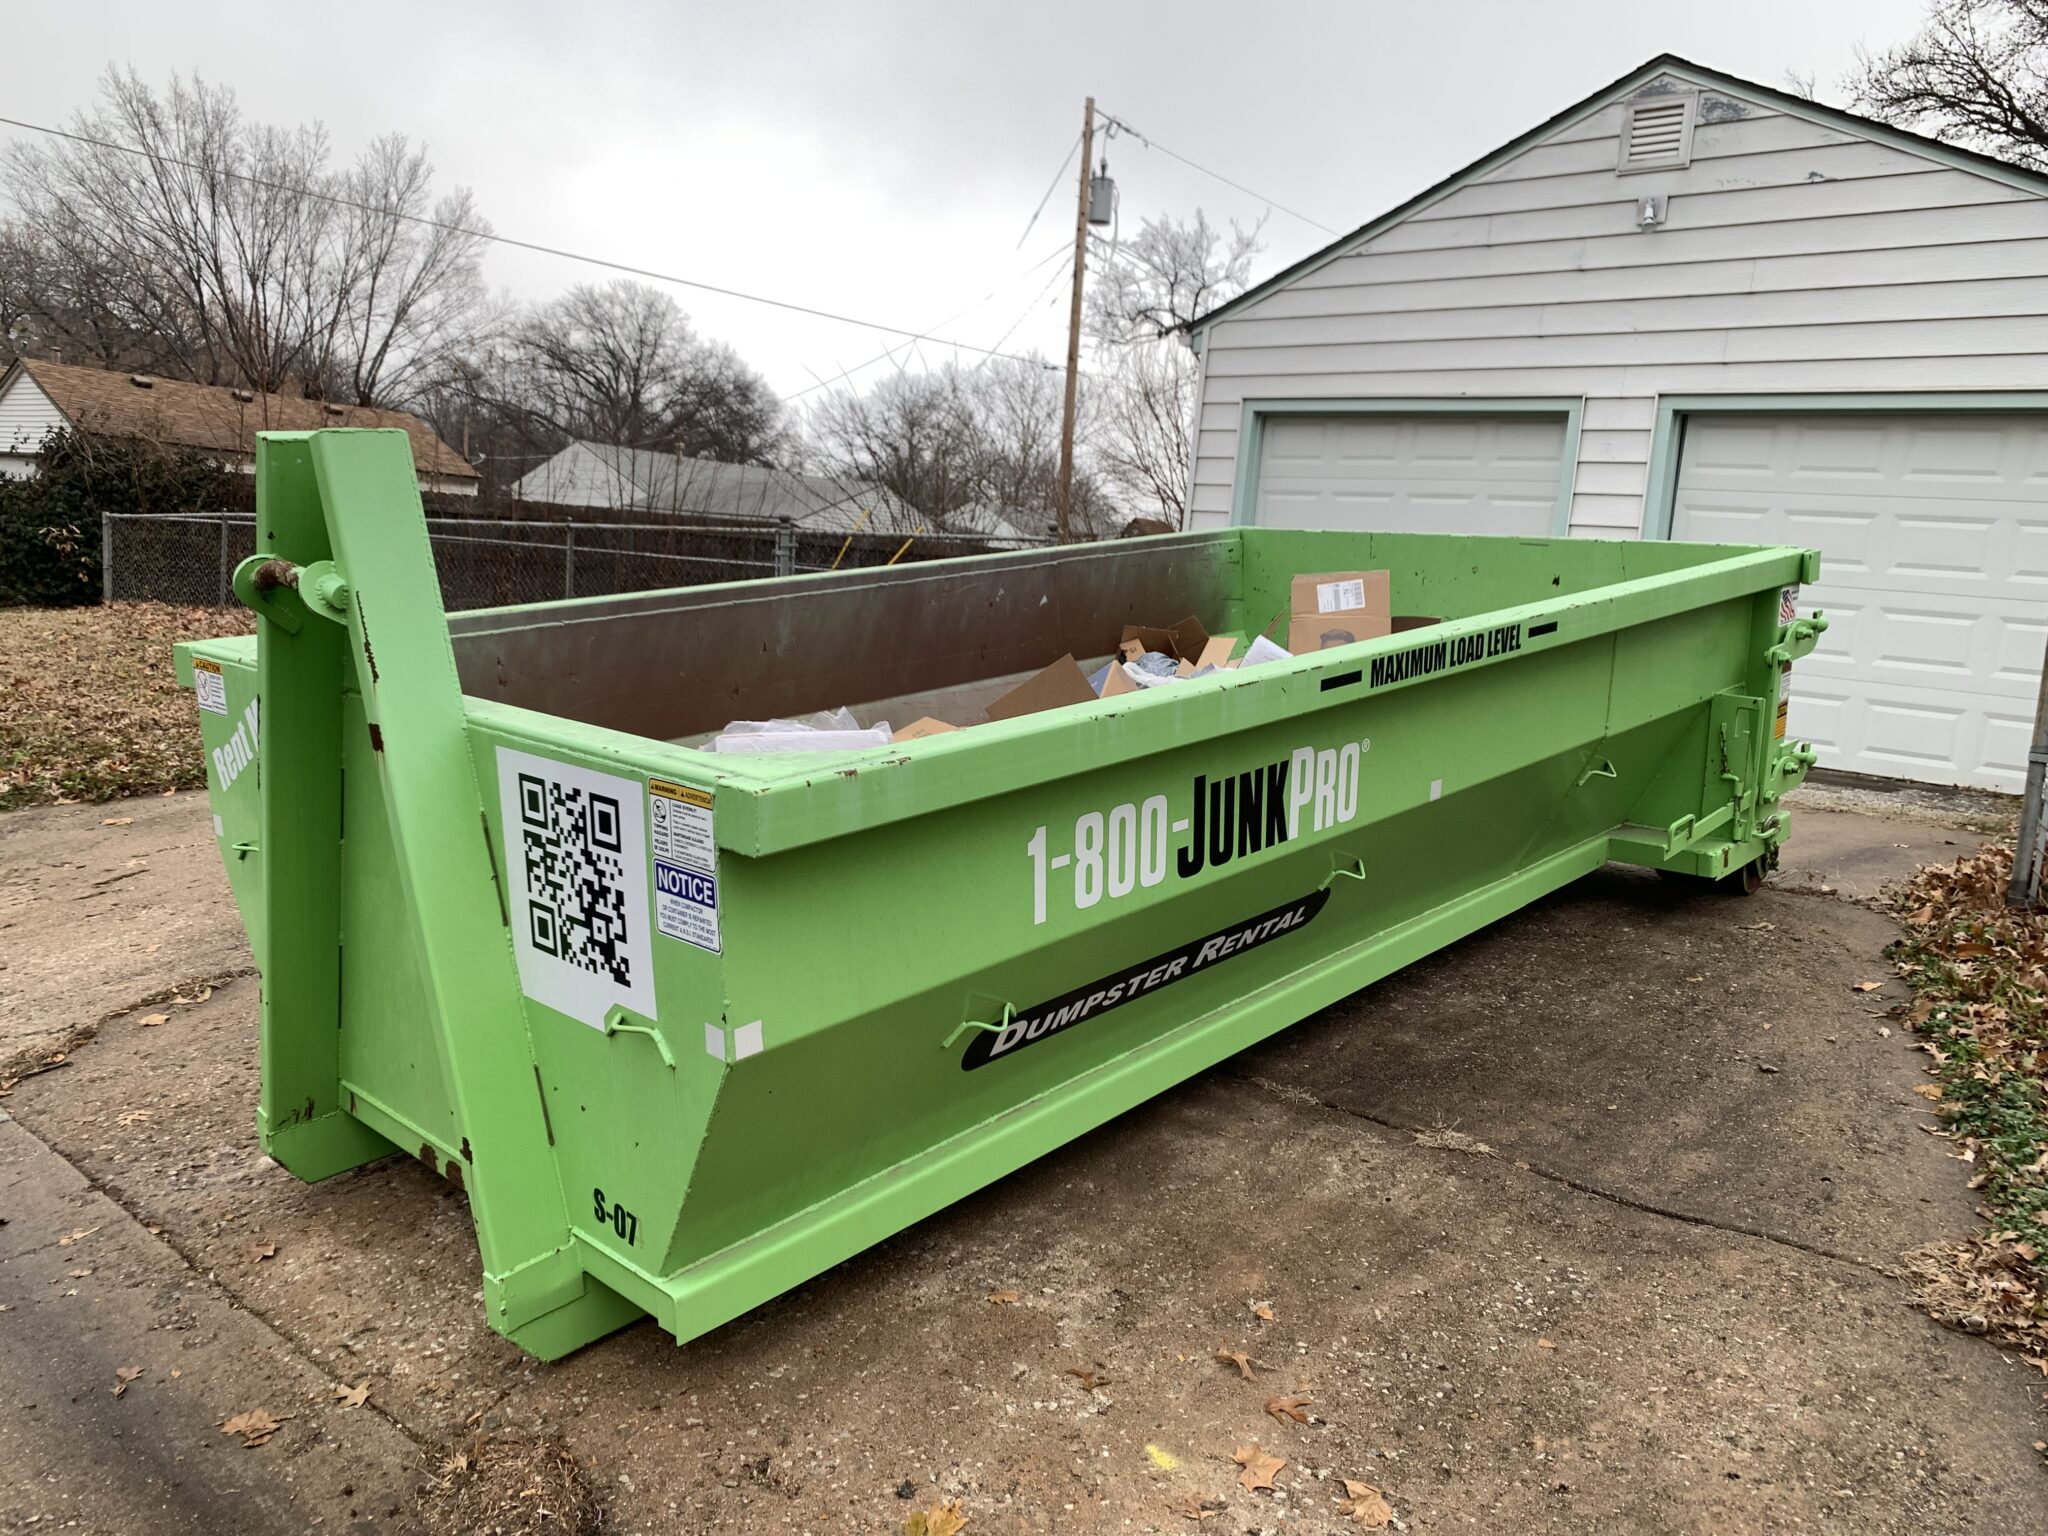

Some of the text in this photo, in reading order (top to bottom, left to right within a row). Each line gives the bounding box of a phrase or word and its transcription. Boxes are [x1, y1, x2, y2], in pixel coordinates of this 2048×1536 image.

[199, 660, 220, 673] CAUTION
[1370, 623, 1522, 689] MAXIMUM LOAD LEVEL
[212, 720, 254, 793] Rent
[655, 785, 677, 796] WARNING
[657, 866, 714, 906] NOTICE
[989, 905, 1306, 1058] DUMPSTER RENTAL
[593, 1187, 637, 1248] S-07
